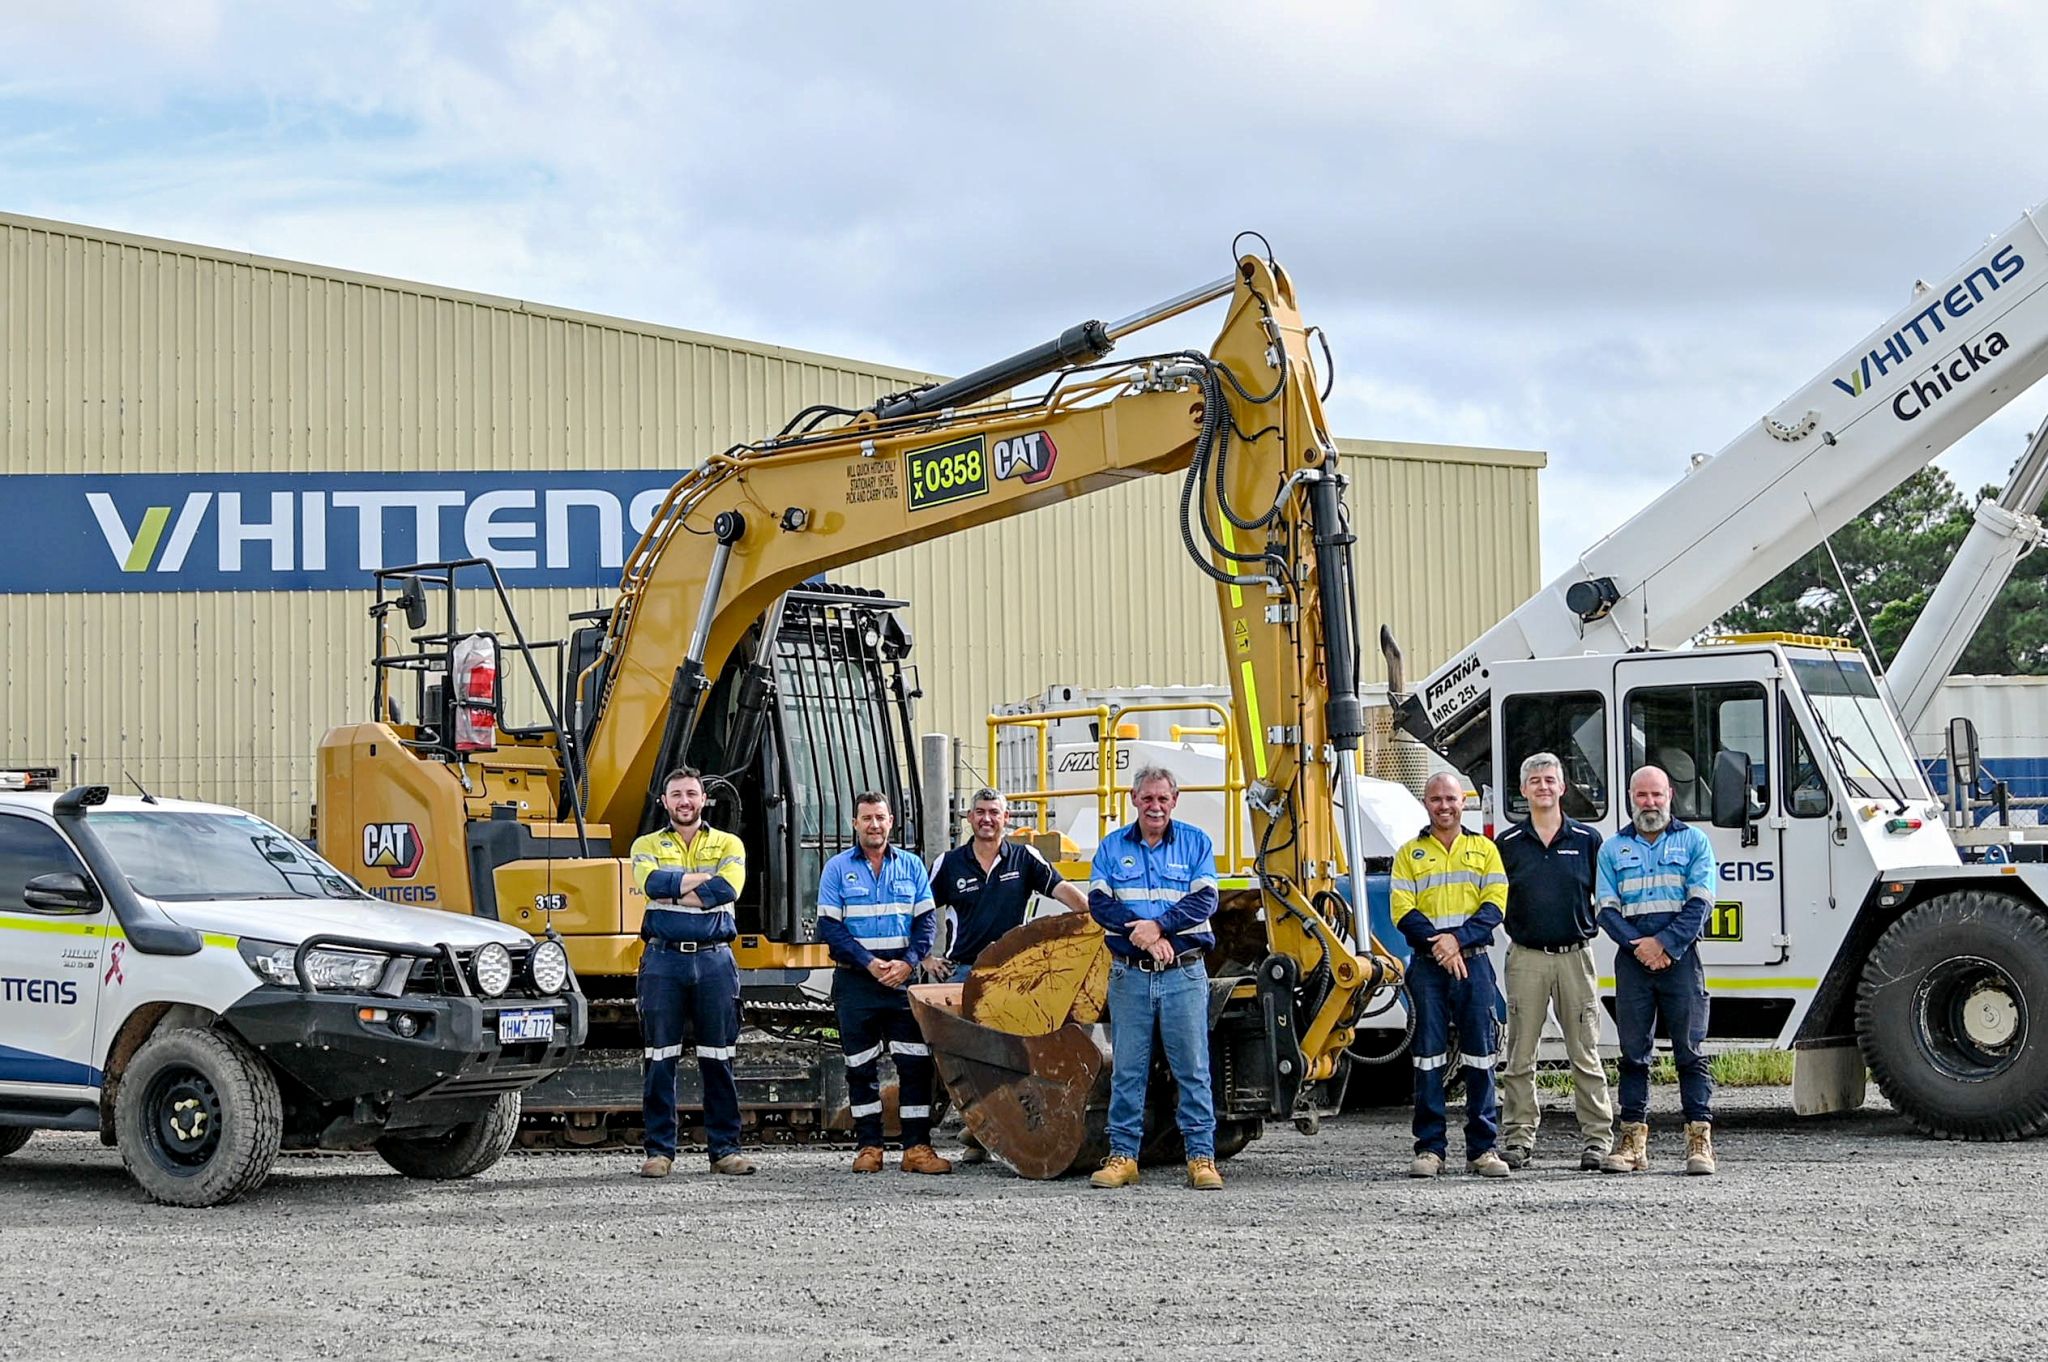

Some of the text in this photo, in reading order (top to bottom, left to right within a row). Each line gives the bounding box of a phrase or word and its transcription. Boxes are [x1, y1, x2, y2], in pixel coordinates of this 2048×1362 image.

[1832, 244, 2025, 398] WHITTENS
[1892, 331, 2010, 421] Chicka
[884, 459, 897, 473] ONLY
[925, 449, 983, 492] 0358
[994, 432, 1041, 479] CAT
[1425, 656, 1481, 711] FRANNA
[1432, 684, 1478, 724] MRC 25t
[363, 824, 408, 866] CAT
[1716, 862, 1775, 881] ENS
[535, 895, 561, 909] 315
[1, 977, 78, 1004] TTENS
